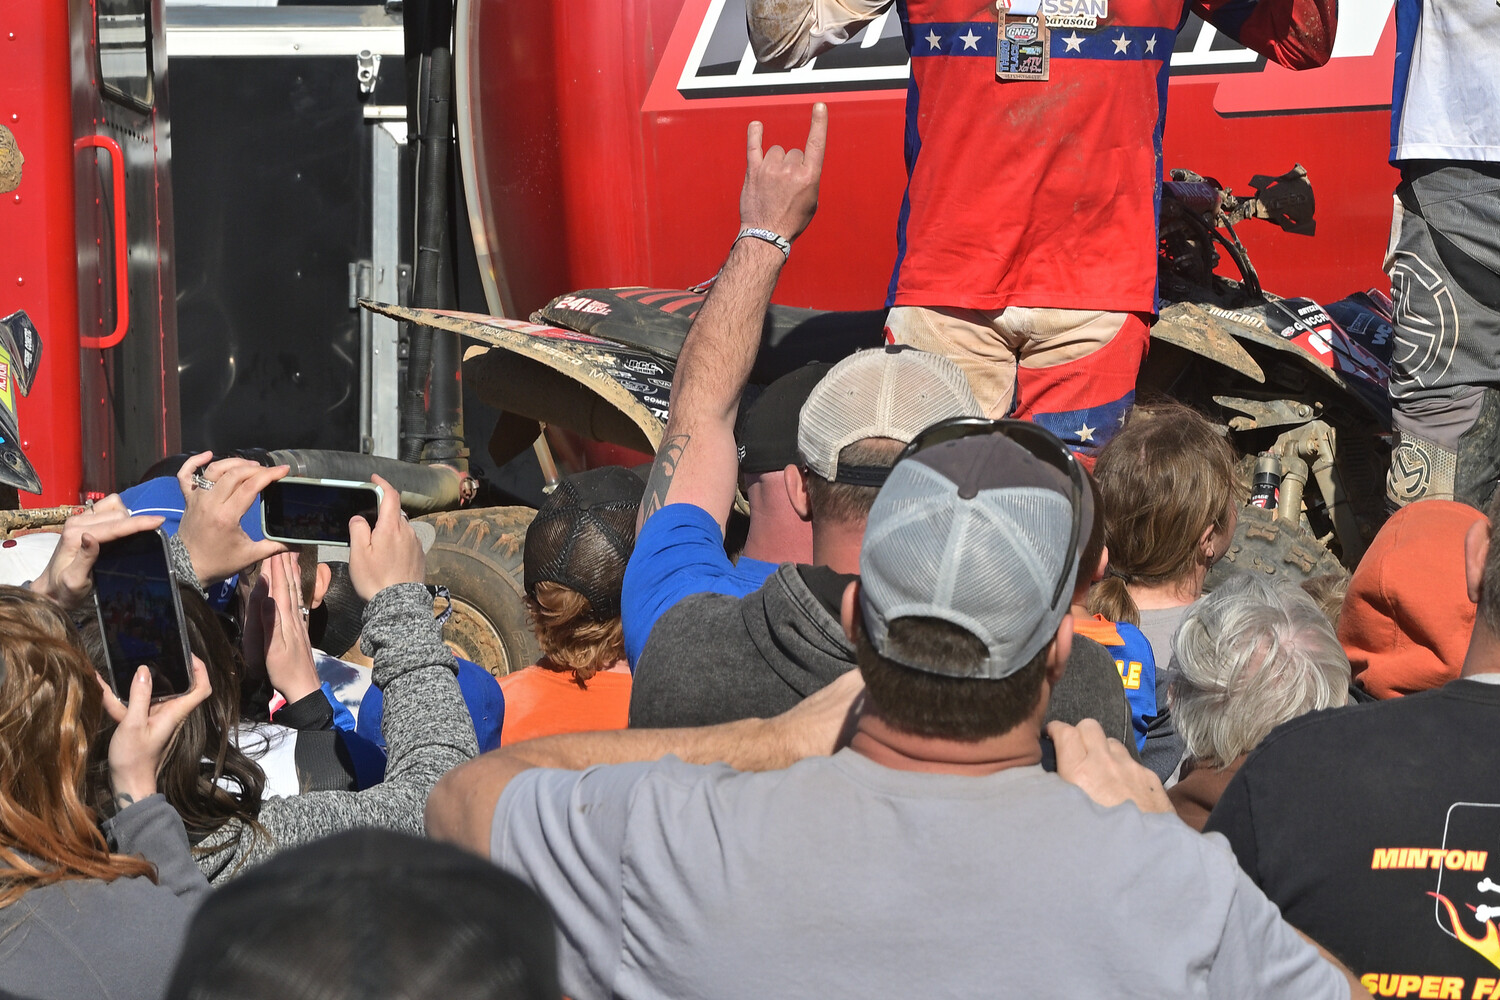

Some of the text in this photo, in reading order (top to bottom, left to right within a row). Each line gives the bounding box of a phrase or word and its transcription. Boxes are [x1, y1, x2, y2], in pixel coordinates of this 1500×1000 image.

[1045, 17, 1095, 27] Sarasota
[554, 295, 593, 311] 241
[1371, 848, 1488, 871] MINTON
[1360, 972, 1467, 999] SUPER
